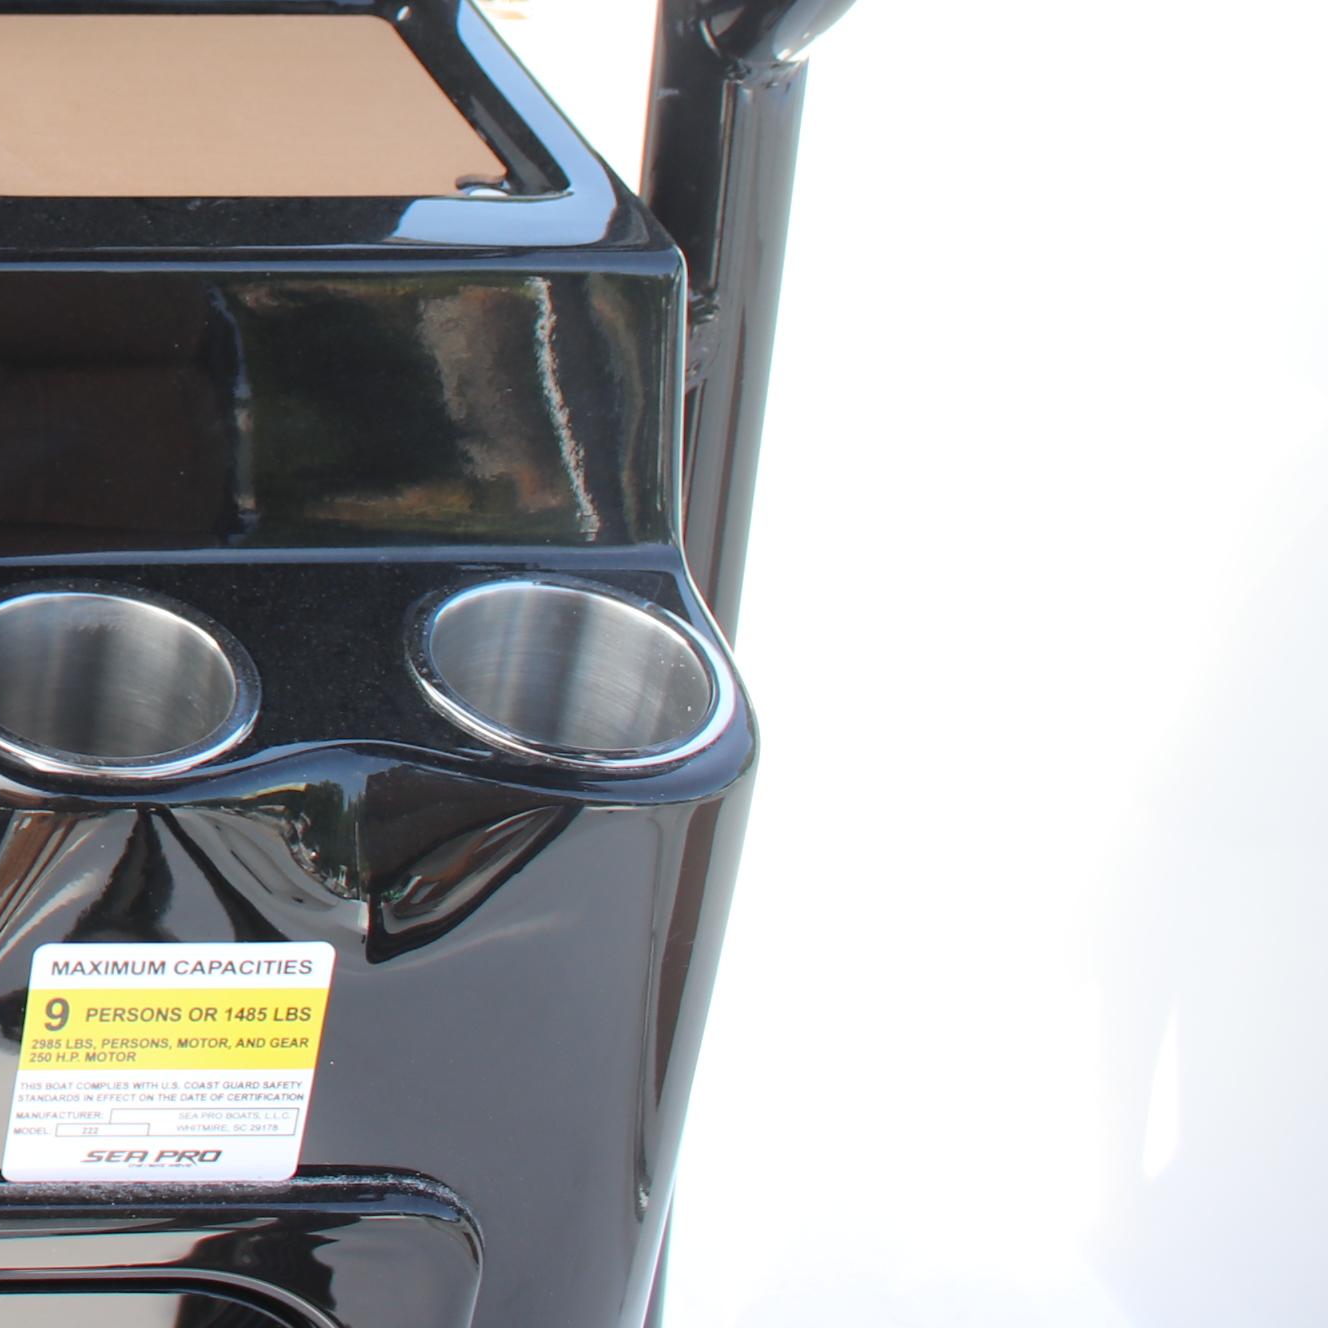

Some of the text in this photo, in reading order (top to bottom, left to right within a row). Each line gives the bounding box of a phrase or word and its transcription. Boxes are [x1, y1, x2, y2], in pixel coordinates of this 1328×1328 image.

[51, 960, 313, 976] MAXIMUM CAPACITIES
[44, 997, 312, 1031] 9 PERSONS OR 1485 LBS
[31, 1038, 310, 1050] 2985 LBS, PERSONS, MOTOR, AND GEAR
[29, 1052, 137, 1062] 250 H.P. MOTOR
[19, 1081, 304, 1090] THIS BOAT COMPLIES WITH U.S. COAST GUARD SAFETY
[18, 1094, 80, 1102] STANDARDS
[82, 1094, 94, 1102] IN
[95, 1094, 135, 1102] EFFECT
[138, 1094, 155, 1102] ON
[157, 1094, 178, 1102] THE
[178, 1094, 208, 1102] DATE
[226, 1093, 306, 1101] CERTIFICATION
[80, 1150, 223, 1166] SEA PRO
